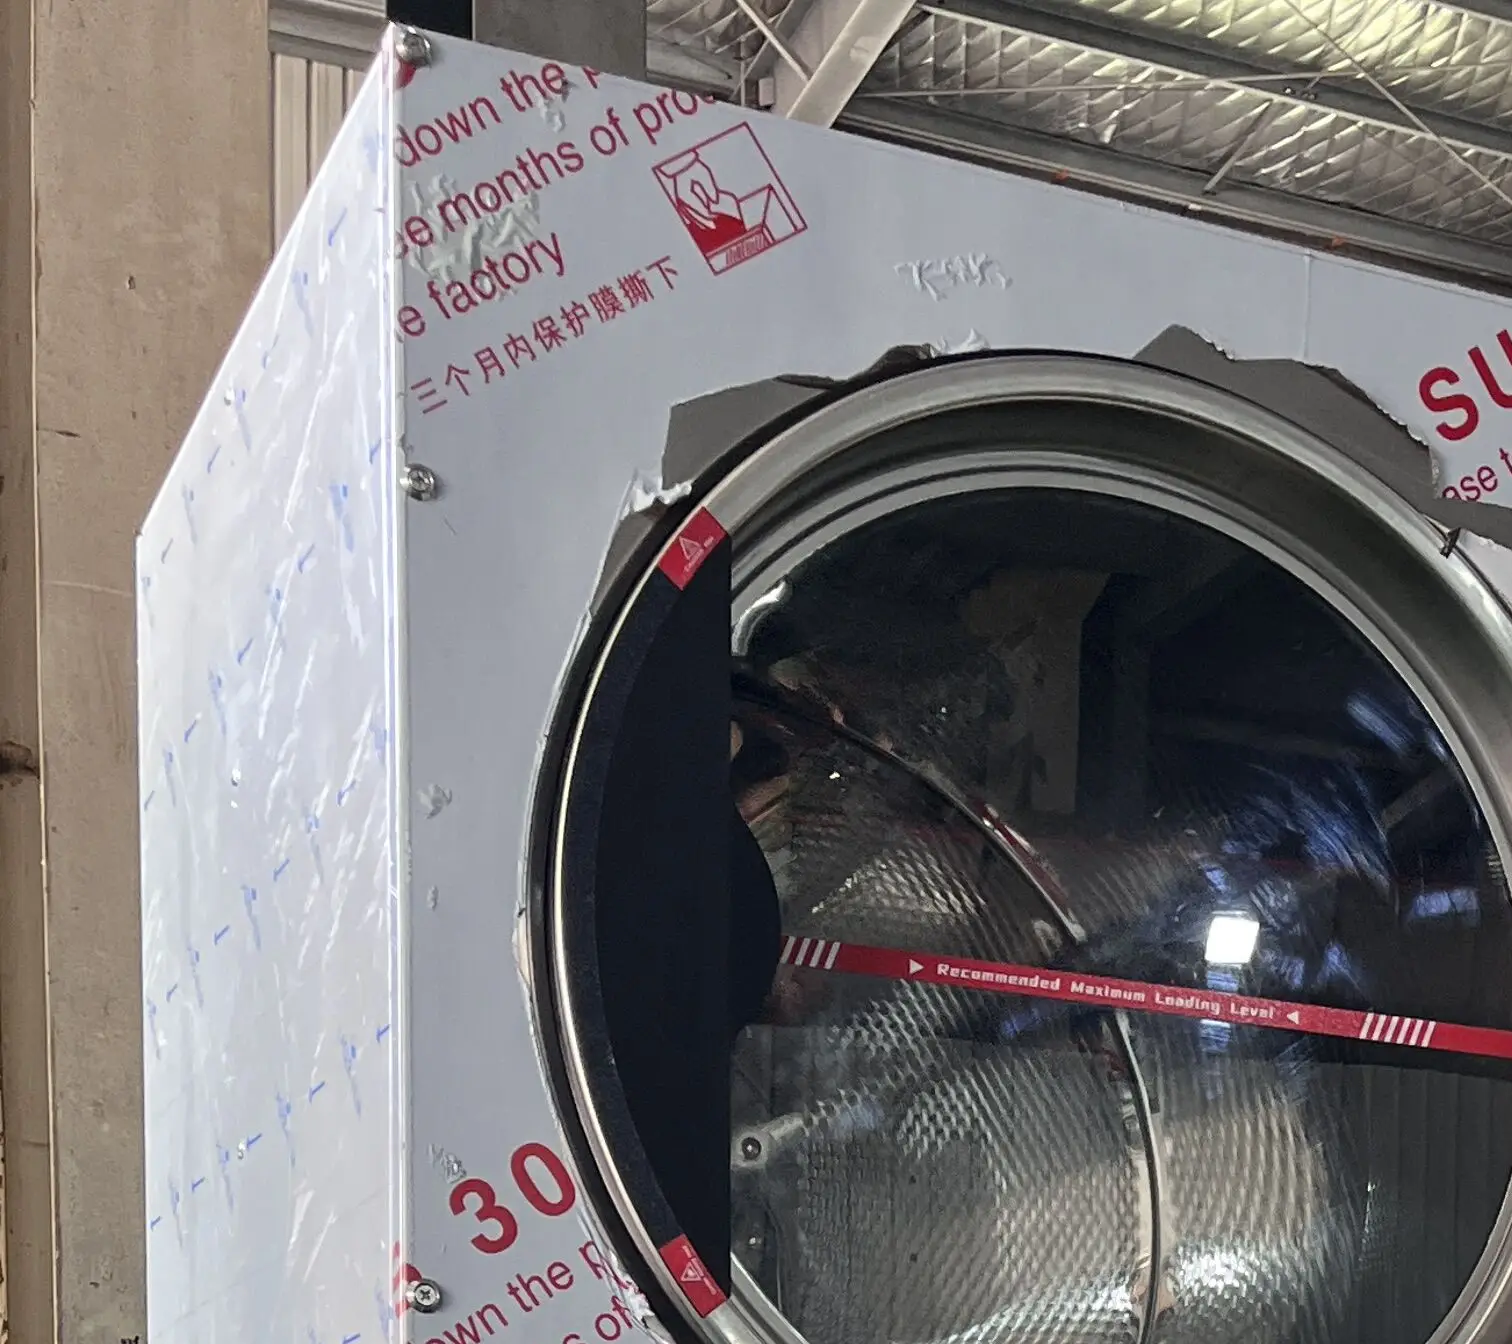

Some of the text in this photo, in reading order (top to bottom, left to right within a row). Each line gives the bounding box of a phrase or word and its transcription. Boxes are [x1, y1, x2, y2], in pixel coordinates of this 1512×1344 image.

[395, 96, 503, 167] down
[500, 62, 567, 113] the
[436, 141, 585, 233] months
[589, 107, 630, 156] of
[426, 231, 566, 321] factory
[410, 255, 679, 414] 三个月内保护膜撕下
[936, 962, 1275, 1020] Recommended Maximum Loading Level
[449, 1142, 577, 1255] 30
[506, 1260, 574, 1313] the
[594, 1295, 634, 1342] of
